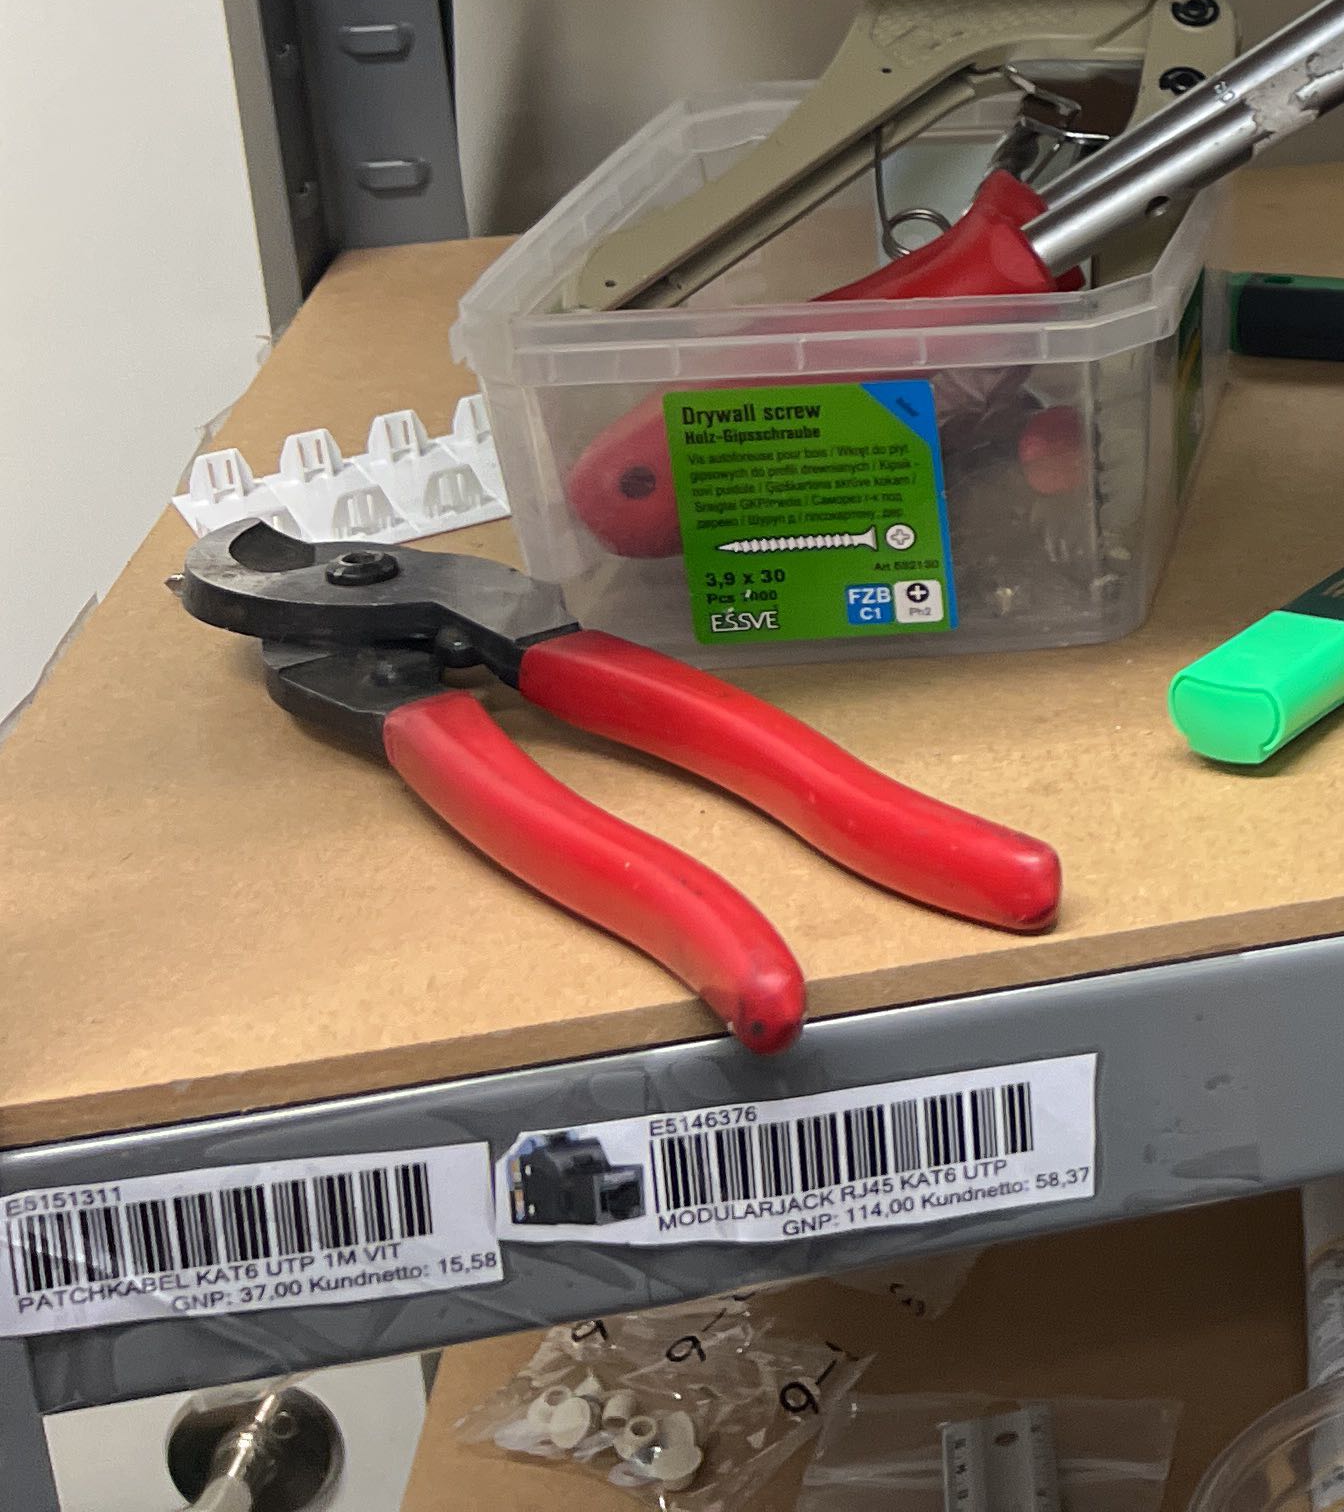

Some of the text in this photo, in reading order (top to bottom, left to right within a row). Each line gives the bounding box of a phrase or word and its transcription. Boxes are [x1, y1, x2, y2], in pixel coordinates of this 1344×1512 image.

[681, 403, 821, 428] Drywall screw
[705, 568, 786, 589] 3,9 x 30
[706, 593, 737, 605] Pcs
[848, 586, 892, 605] FZB
[710, 611, 780, 633] ESSVE
[859, 606, 882, 621] C1
[649, 1105, 758, 1138] E5146376
[659, 1158, 1009, 1232] MODULARJACK RJ45 KAT6 UTP
[781, 1166, 1091, 1238] GNP: 114,00 Kundnetto: 58,37
[18, 1241, 402, 1314] PATCHKABEL KAT6 UTP 1M VIT
[172, 1252, 498, 1314] GNP: 37,00 Kundnetto: 15,58
